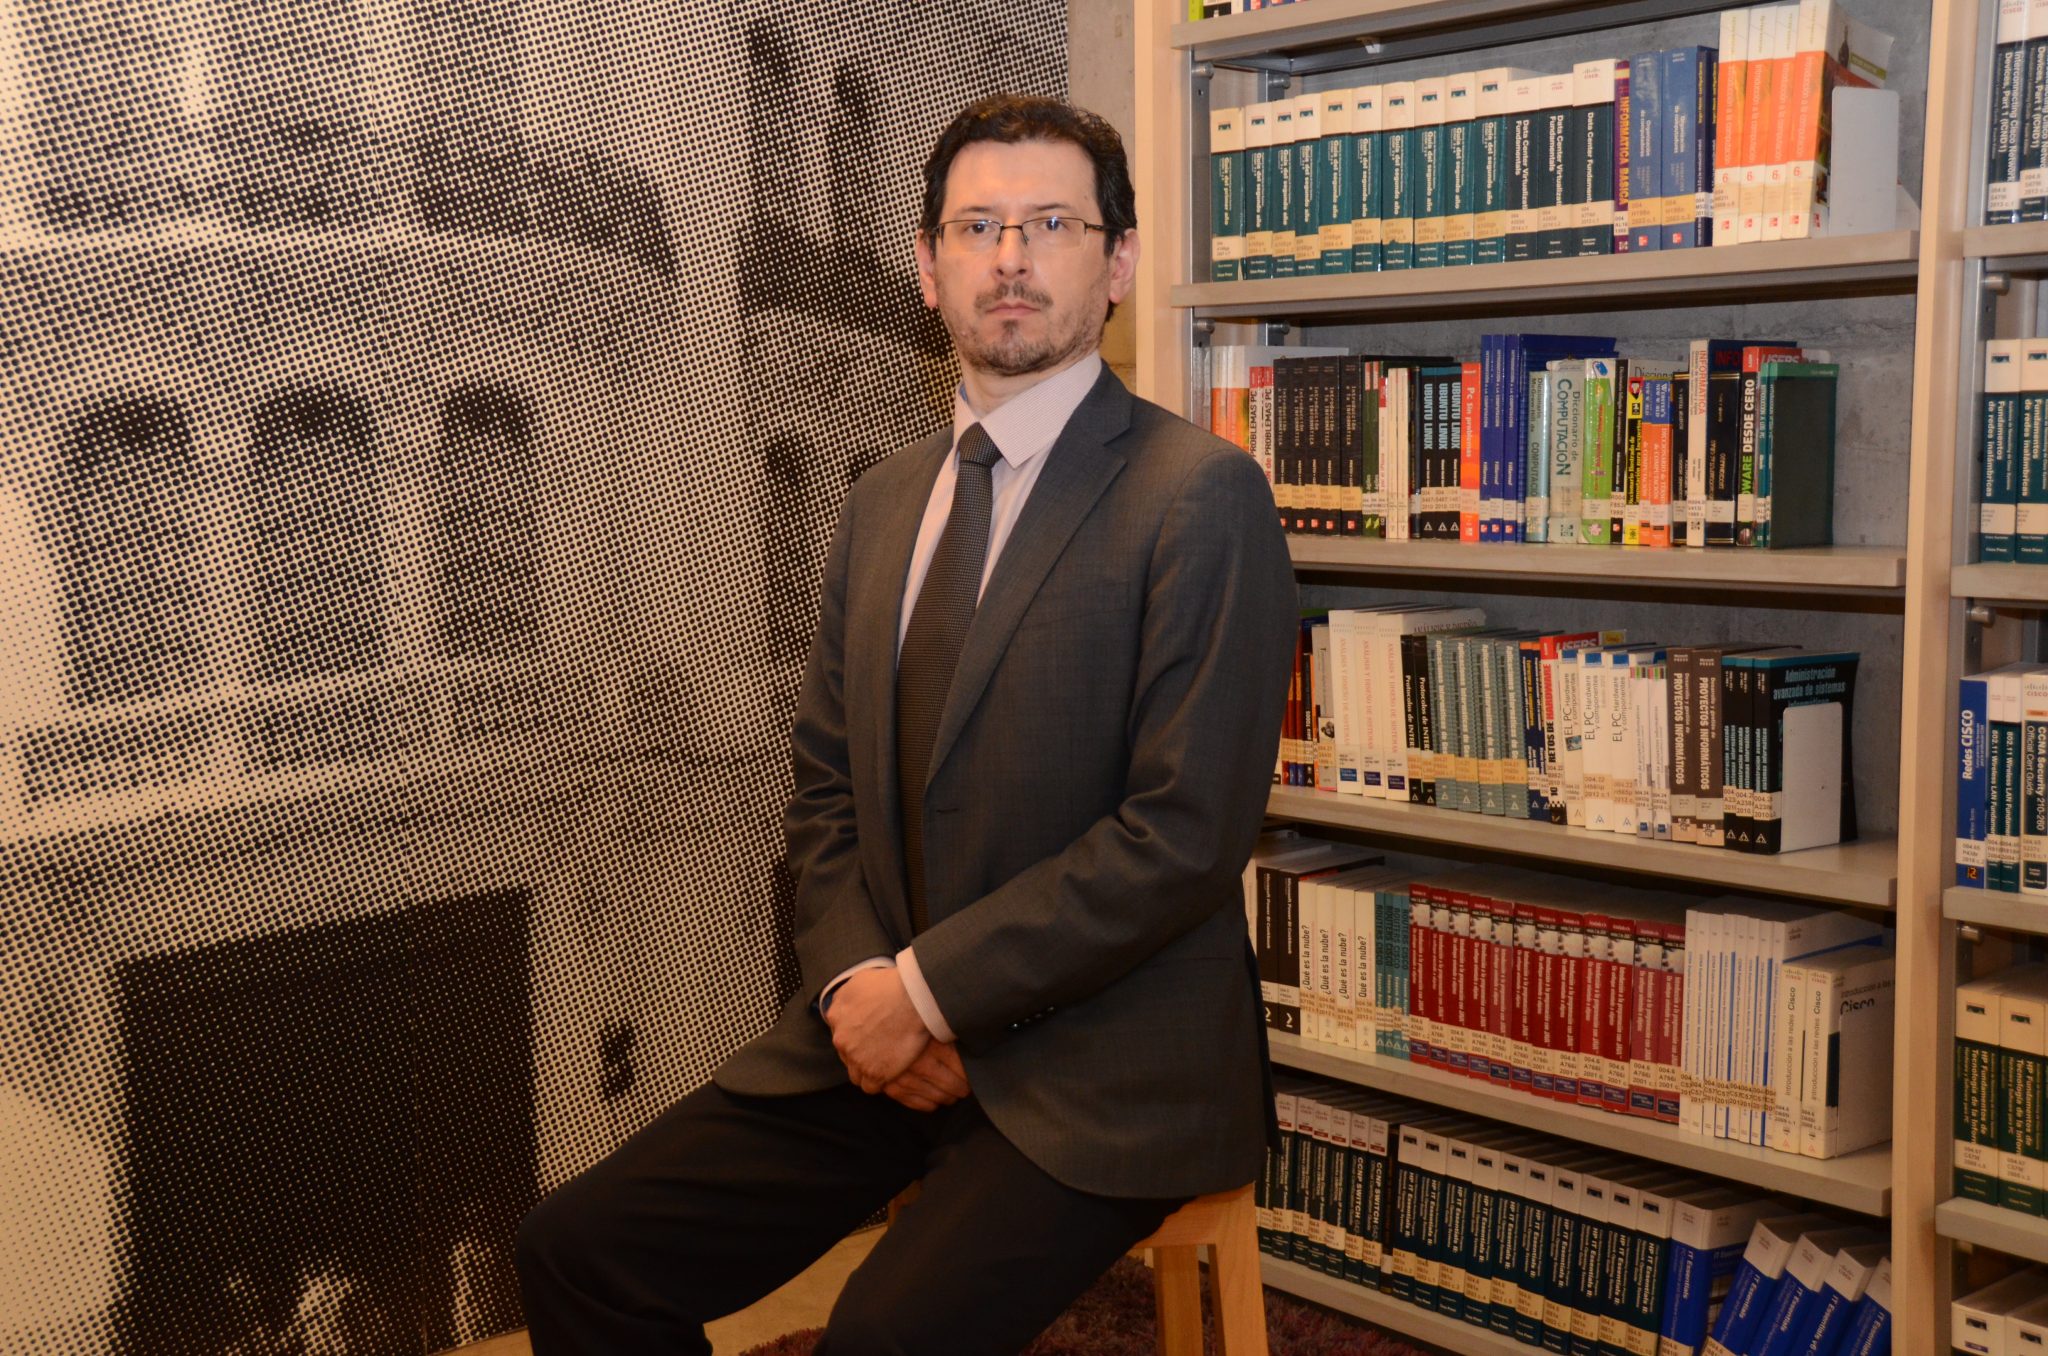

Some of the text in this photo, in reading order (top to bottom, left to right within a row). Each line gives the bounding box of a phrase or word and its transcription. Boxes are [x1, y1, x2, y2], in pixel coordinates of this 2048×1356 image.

[2002, 52, 2013, 89] Devices,
[2009, 51, 2024, 118] Interconnecting
[2002, 90, 2011, 109] Part
[1998, 118, 2008, 153] (ICND1)
[2009, 120, 2017, 144] Cisco
[1619, 97, 1629, 205] INFORMATICA BASICA
[1722, 173, 1728, 182] 6
[1747, 171, 1753, 180] 6
[1772, 170, 1779, 179] 6
[1794, 167, 1800, 176] 6
[1250, 391, 1257, 401] PC
[1265, 389, 1271, 400] PC
[1744, 379, 1755, 410] CERO
[1988, 401, 1995, 412] de
[2025, 400, 2031, 410] de
[1424, 384, 1433, 449] UBUNTU LINUX
[1439, 383, 1448, 450] UBUNTU LINUX
[1452, 382, 1461, 449] UBUNTU LINUX
[1556, 379, 1572, 475] COMPUTACION
[1571, 392, 1580, 461] Diccionario de
[1465, 416, 1473, 457] problemas
[1743, 414, 1753, 453] DESDE
[1997, 401, 2005, 460] Fundamentos
[2033, 399, 2041, 459] Fundamentos
[1986, 441, 1994, 497] inalámbricas
[2022, 440, 2030, 496] inalámbricas
[1773, 681, 1846, 700] avanzada de sistemas
[1546, 722, 1554, 733] DE
[1585, 712, 1594, 726] PC
[1611, 713, 1621, 727] PC
[1674, 674, 1686, 784] PROYECTOS INFORMÁTICOS
[1585, 728, 1595, 740] EL
[1612, 730, 1622, 742] EL
[1700, 677, 1712, 790] PROYECTOS INFORMÁTICOS
[1961, 710, 1973, 780] Redes CISCO
[1547, 735, 1556, 762] RETOS
[2026, 772, 2034, 795] Guide
[2036, 727, 2046, 830] CCNA Security 210-260
[1550, 787, 1557, 796] 10
[1302, 925, 1310, 948] nube?
[1320, 929, 1329, 954] nube?
[1358, 936, 1367, 960] nube?
[1304, 960, 1310, 968] es
[1322, 964, 1329, 973] es
[1338, 932, 1349, 1000] ¿Qué es la nube?
[1361, 972, 1367, 980] es
[1302, 971, 1312, 990] ¿Qué
[1320, 976, 1331, 995] ¿Qué
[1788, 987, 1796, 1011] Cisco
[1982, 1051, 1988, 1063] HP
[1980, 1124, 1987, 1135] de
[1354, 1183, 1362, 1220] SWITCH
[1373, 1162, 1383, 1225] CCNP SWITCH
